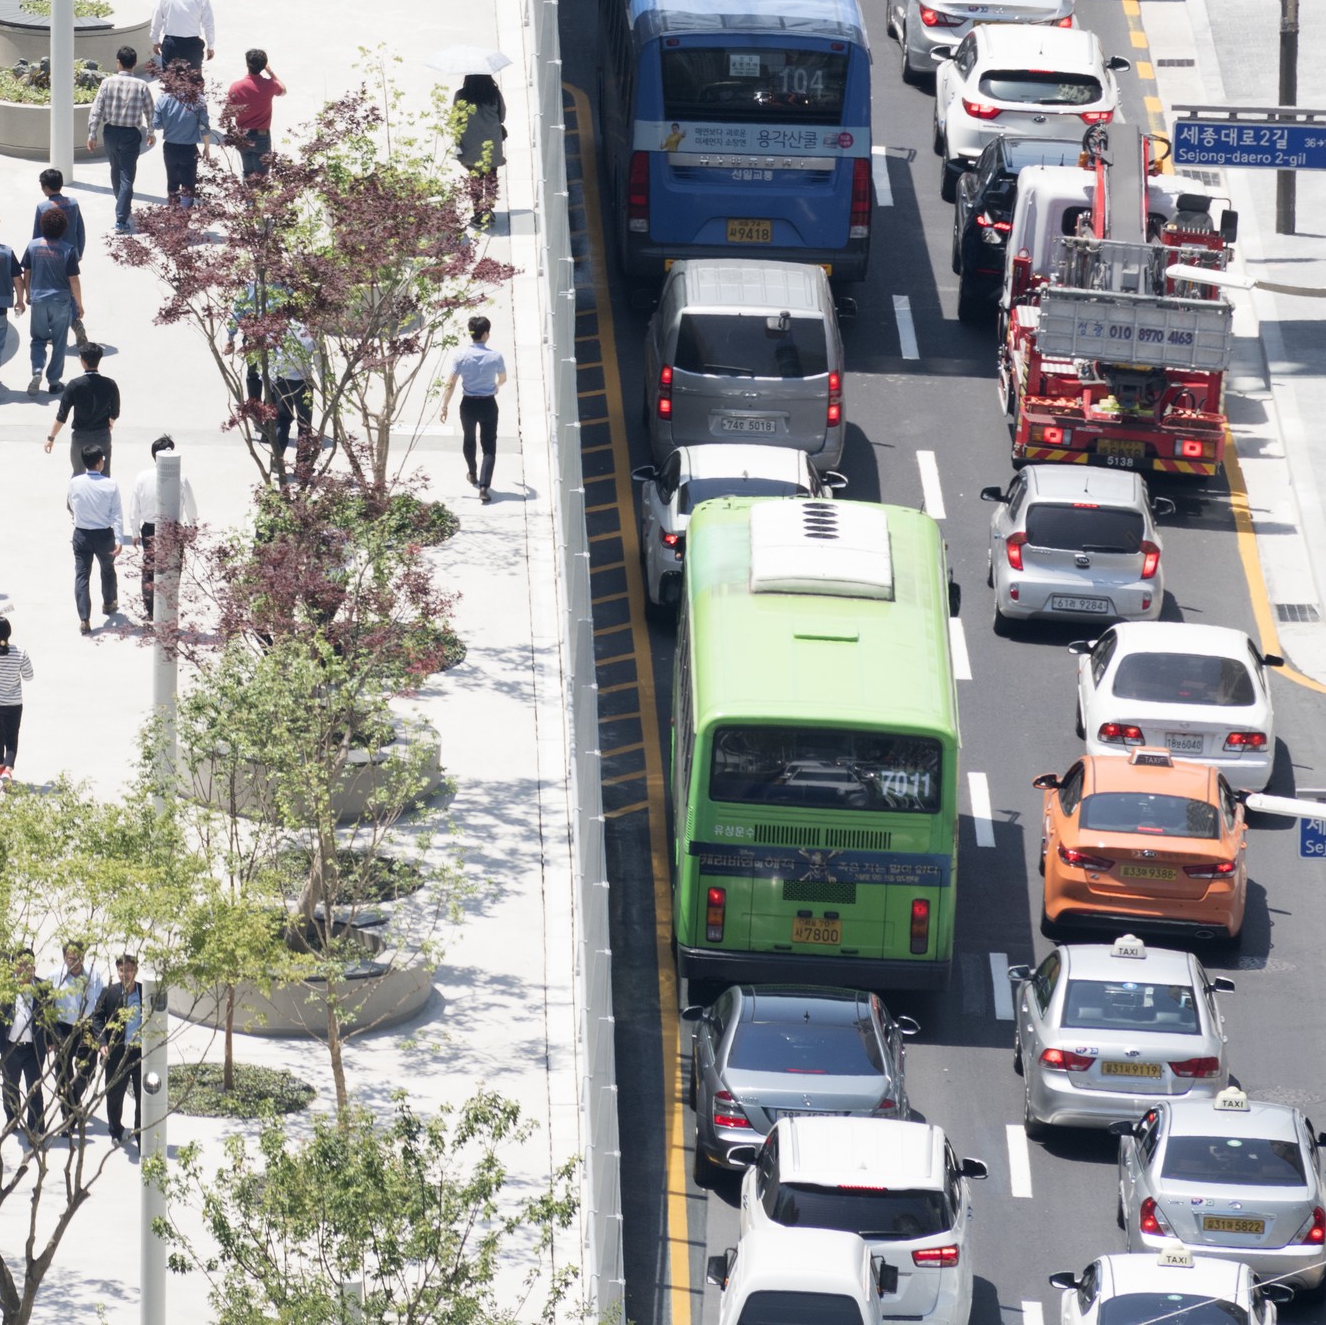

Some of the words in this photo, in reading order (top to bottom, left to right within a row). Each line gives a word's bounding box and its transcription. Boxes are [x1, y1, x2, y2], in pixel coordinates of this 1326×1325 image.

[779, 67, 824, 94] 104
[756, 129, 818, 149] 용각산쿨
[1180, 126, 1288, 149] 세종대로2길
[1179, 149, 1271, 164] Sejong-daero
[1275, 152, 1306, 167] 2-gil
[738, 228, 770, 240] 9418
[1109, 325, 1132, 339] 010
[1138, 328, 1164, 343] 8970
[1167, 331, 1193, 345] 4163
[749, 421, 772, 431] 5018
[1107, 456, 1134, 467] 5138
[1079, 600, 1103, 610] 9284
[881, 771, 930, 797] 7011
[714, 824, 755, 838] 유성운수
[1149, 869, 1173, 879] 9388
[804, 928, 839, 942] 7800
[1119, 947, 1138, 956] TAXI
[1133, 1064, 1157, 1075] 9119
[1222, 1100, 1244, 1108] TAXI
[1235, 1221, 1261, 1232] 5822
[1166, 1255, 1188, 1265] TAXI
